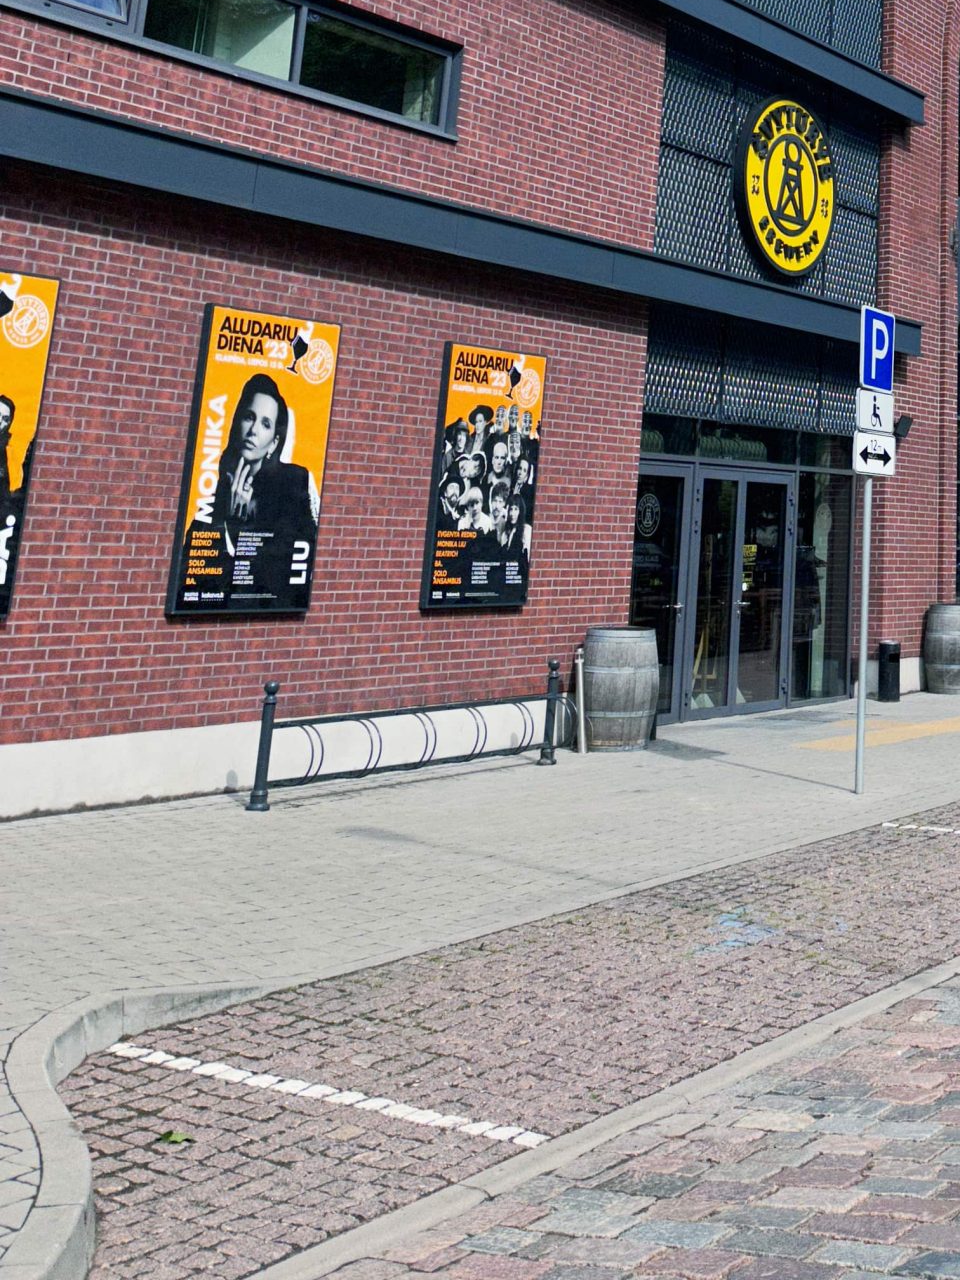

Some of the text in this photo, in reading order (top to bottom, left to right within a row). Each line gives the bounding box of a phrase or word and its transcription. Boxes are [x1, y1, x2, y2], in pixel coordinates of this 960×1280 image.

[758, 215, 820, 262] BREWERY
[217, 333, 264, 355] DIENA
[871, 318, 889, 380] P
[453, 367, 489, 385] DIENA
[194, 394, 228, 524] MONIKA
[191, 539, 213, 547] REDKO
[192, 531, 221, 539] EVGENYA
[189, 549, 219, 557] BEATRICH
[289, 541, 310, 585] LIU
